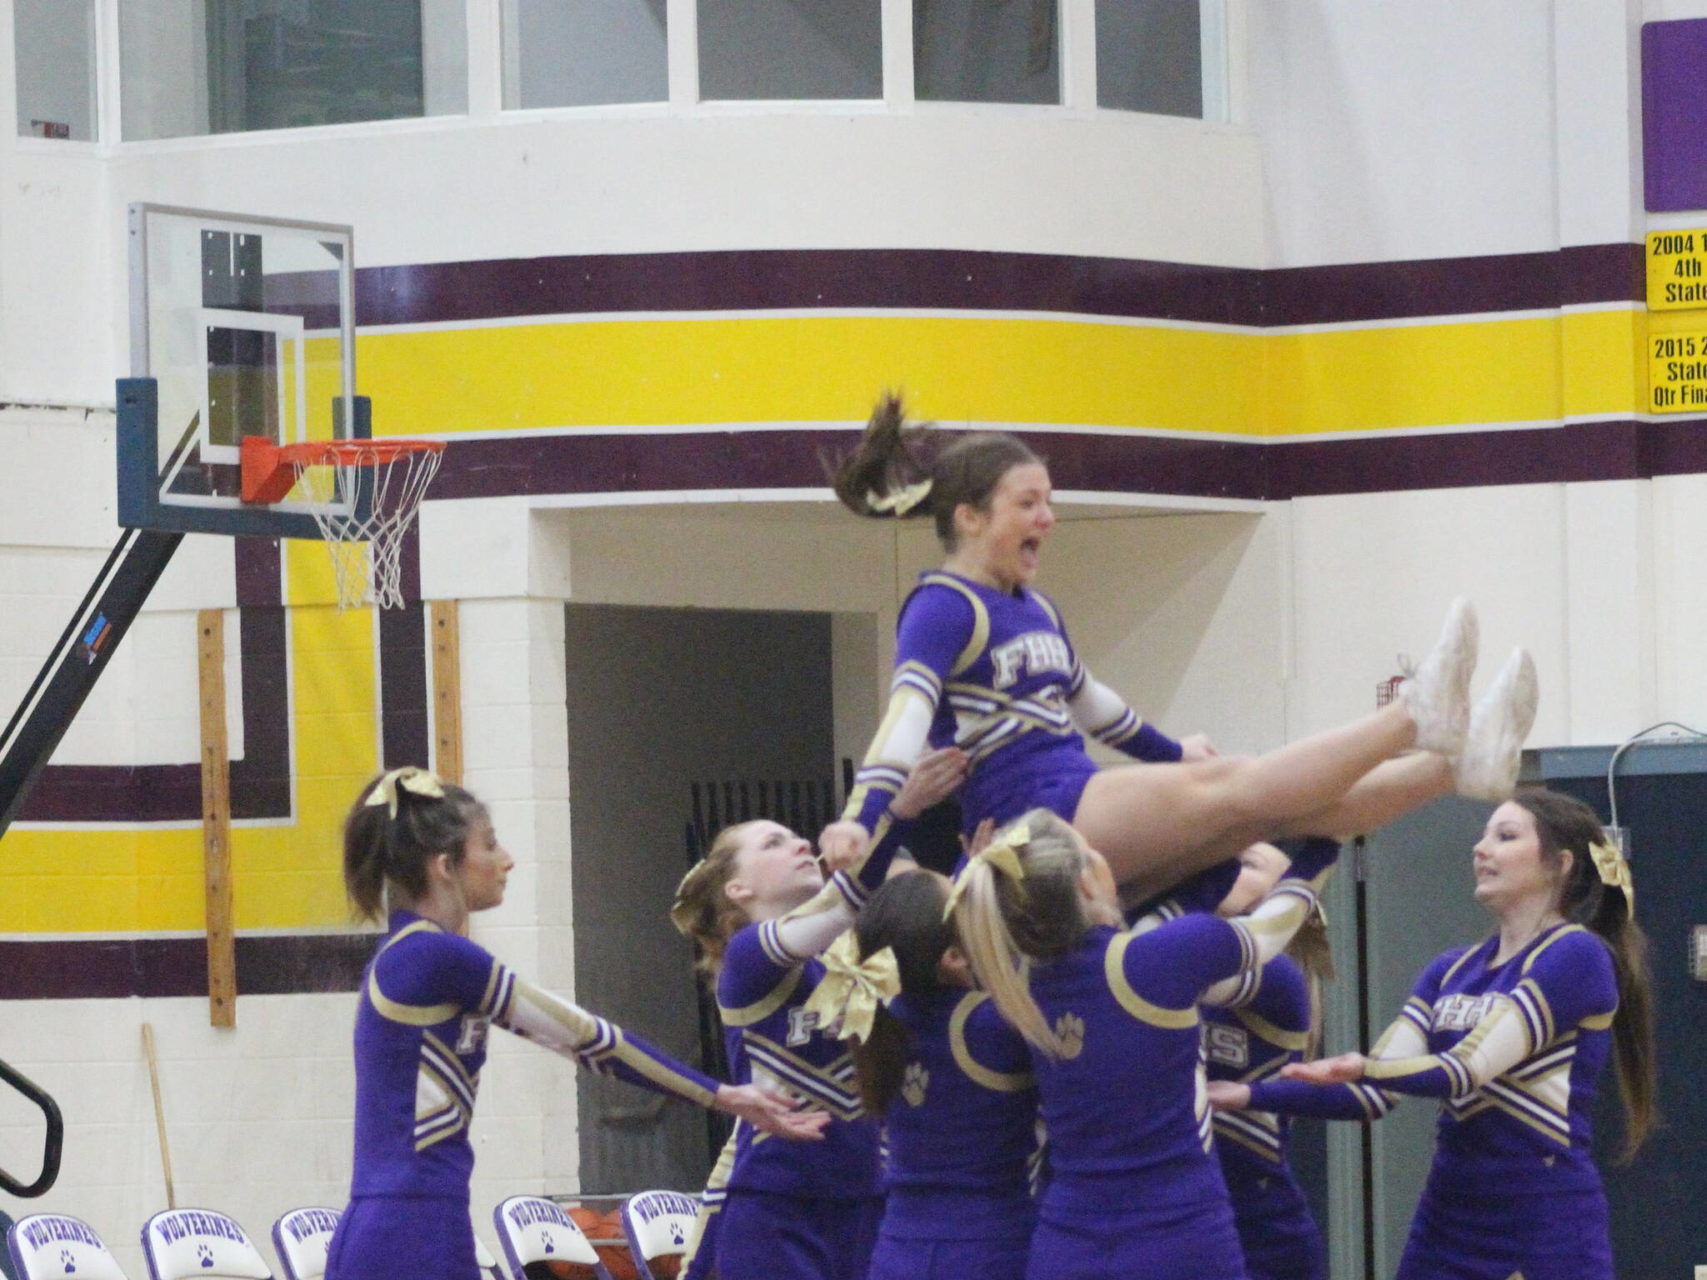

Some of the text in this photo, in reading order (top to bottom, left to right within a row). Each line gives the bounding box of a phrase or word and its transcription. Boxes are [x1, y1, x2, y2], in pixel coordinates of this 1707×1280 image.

[1653, 234, 1694, 255] 2004
[1674, 258, 1702, 278] 4th
[1655, 337, 1695, 358] 2015
[1654, 385, 1707, 408] Qtr Fin
[508, 1200, 576, 1232] WOLVERINES
[633, 1193, 700, 1225] WOLVERINE
[22, 1217, 102, 1252] WOLVERINES
[155, 1213, 245, 1246] WOLVERINES
